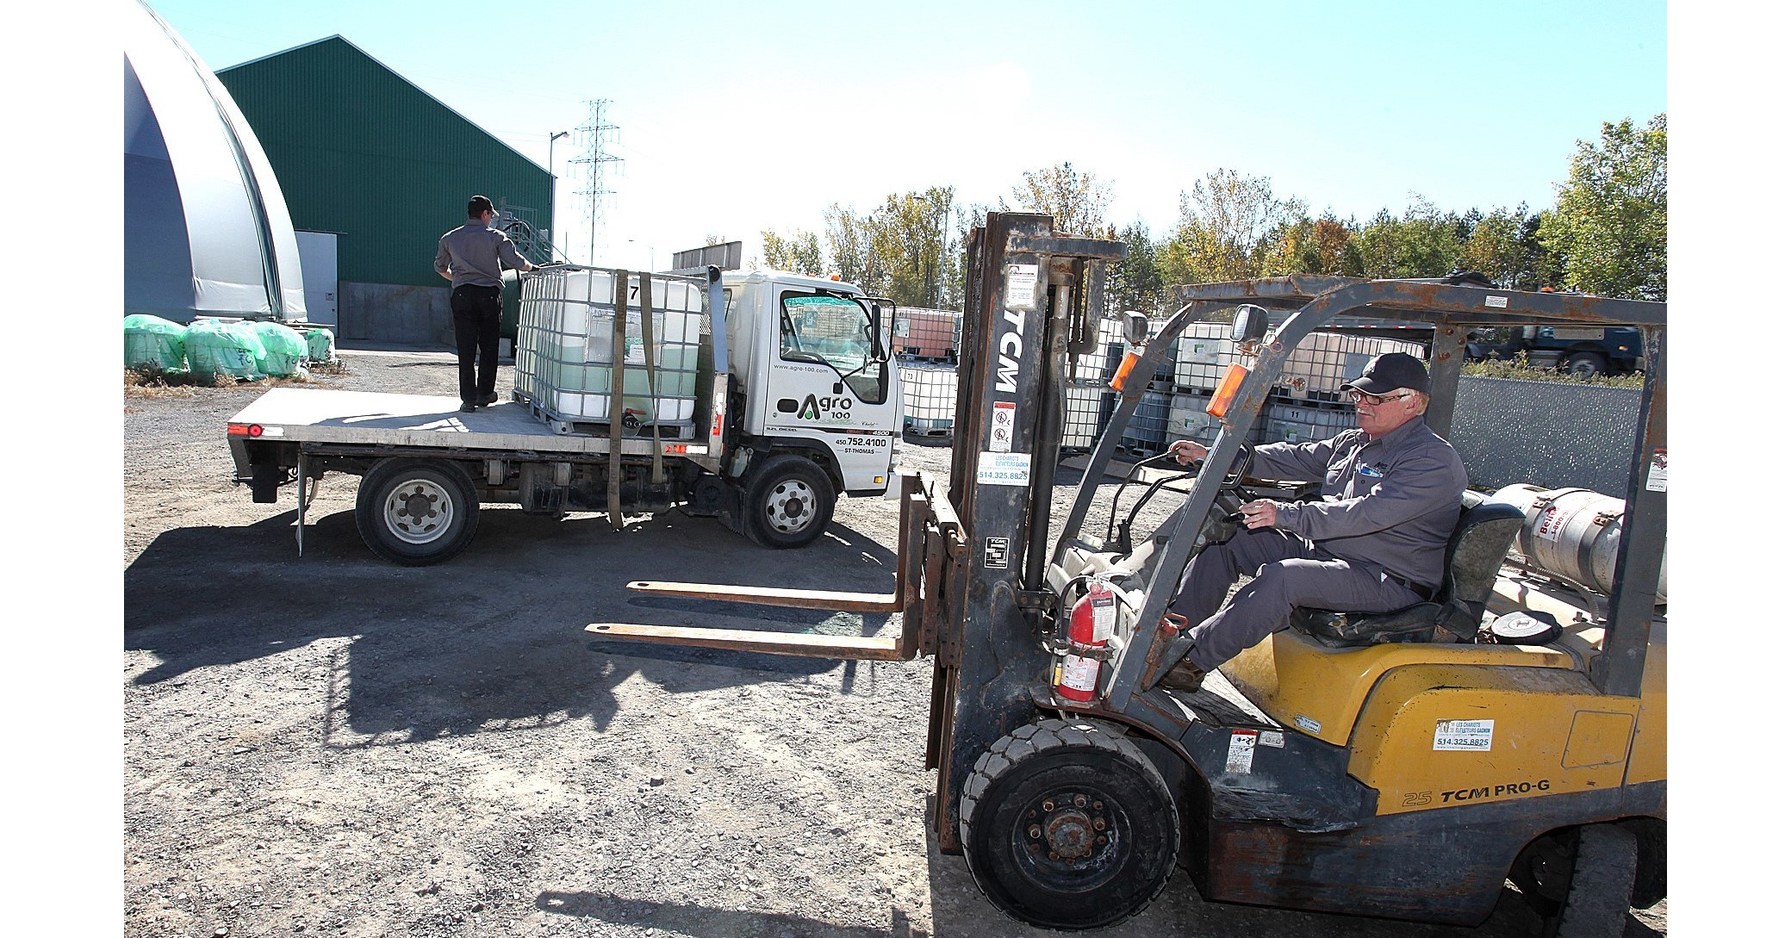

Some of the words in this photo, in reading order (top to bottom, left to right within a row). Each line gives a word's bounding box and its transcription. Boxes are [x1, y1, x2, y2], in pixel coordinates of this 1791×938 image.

[630, 285, 639, 300] 7
[995, 308, 1026, 394] TCM
[797, 393, 852, 419] Agro
[831, 411, 851, 419] 100
[1291, 410, 1299, 418] 11
[979, 471, 1029, 480] 514.325.8825
[1437, 738, 1489, 746] 514.325.8825
[1402, 791, 1432, 807] 25
[1441, 787, 1490, 802] TCM
[1494, 780, 1550, 796] PRO-G
